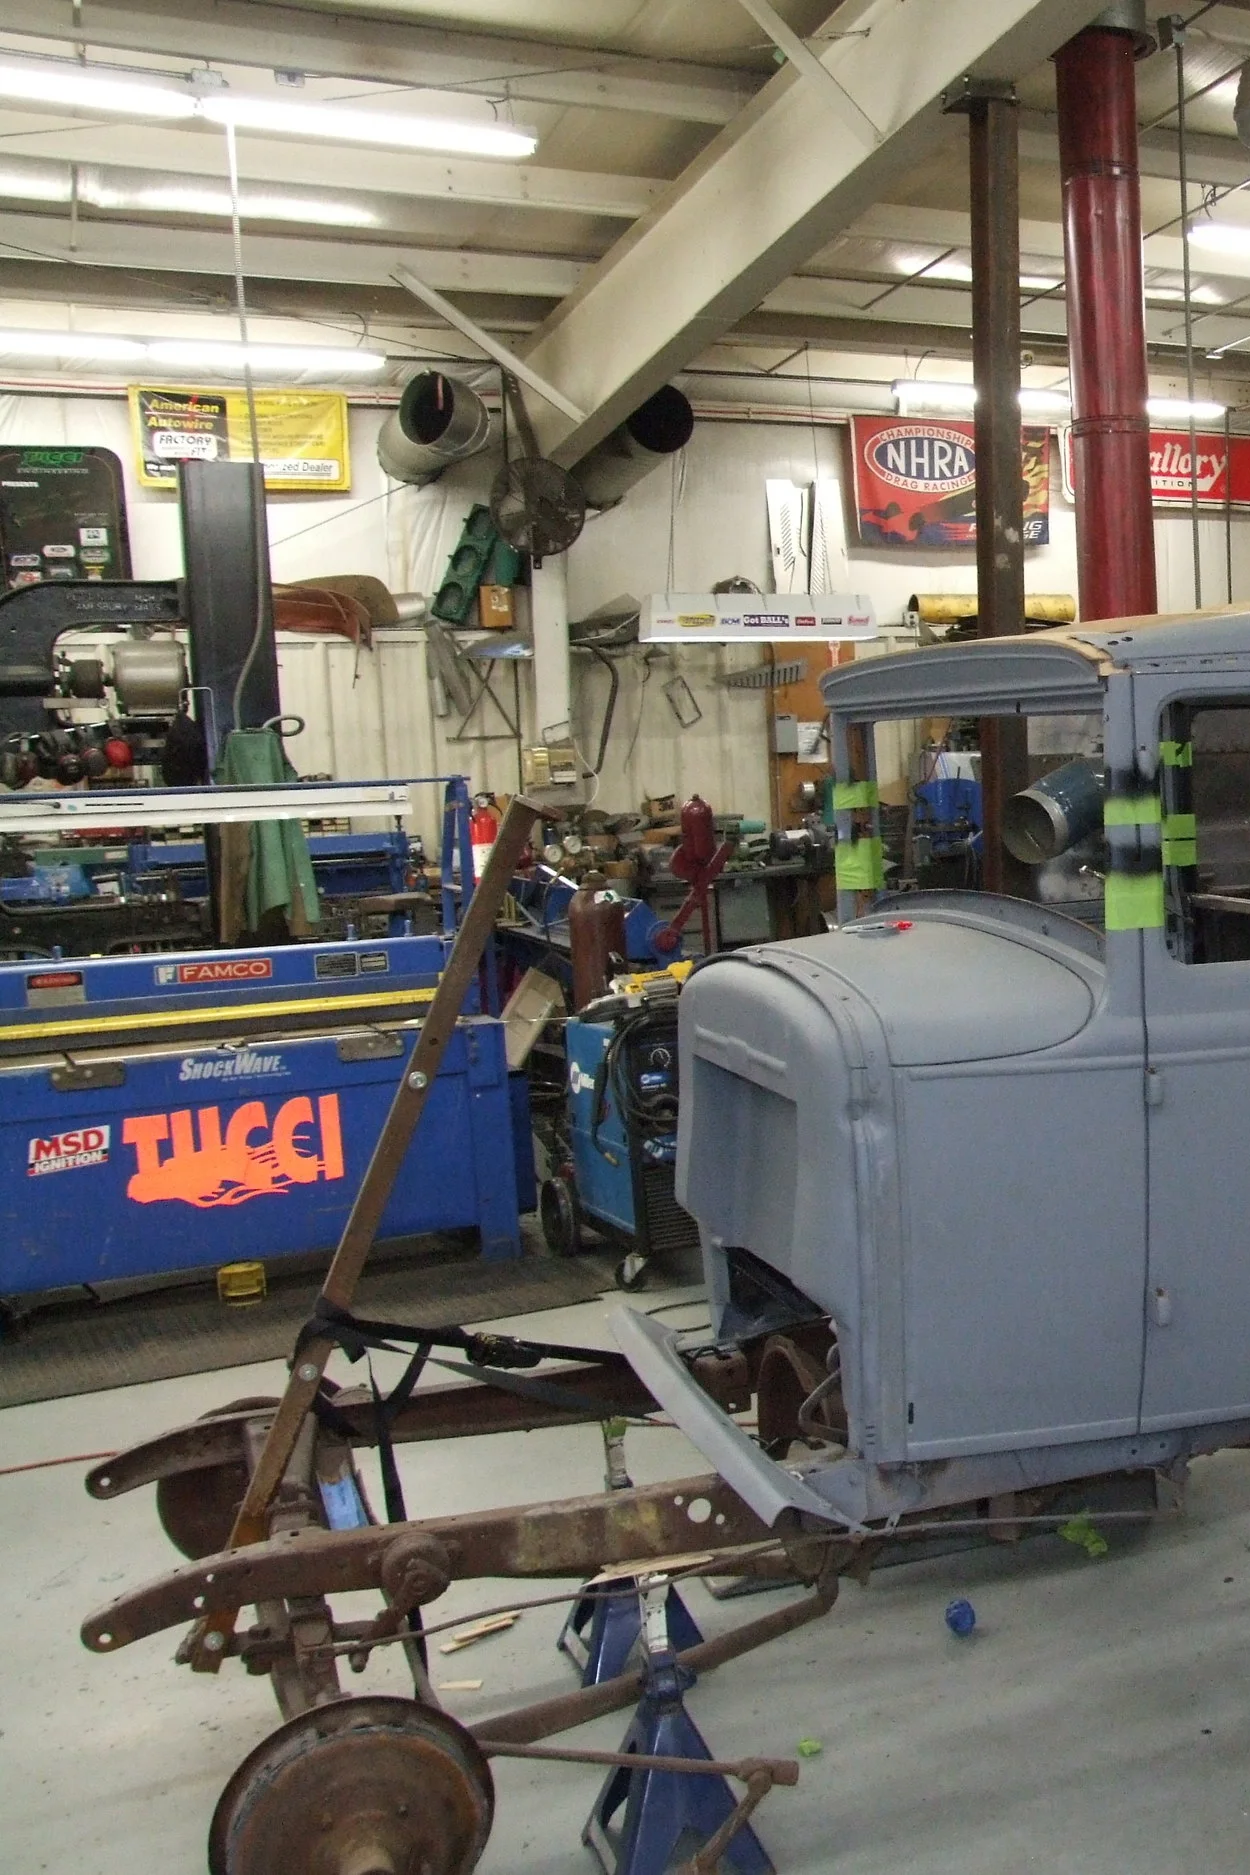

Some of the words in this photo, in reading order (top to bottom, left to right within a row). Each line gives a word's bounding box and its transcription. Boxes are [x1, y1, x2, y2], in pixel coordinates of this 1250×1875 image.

[149, 400, 219, 413] American
[147, 416, 214, 430] Autowire
[158, 434, 212, 446] FACTORY
[301, 461, 333, 473] Dealer
[886, 439, 969, 479] NHRA
[1149, 441, 1227, 476] allory
[884, 471, 919, 490] DRAG
[743, 616, 759, 624] Got
[182, 961, 267, 983] FAMCO
[34, 1128, 105, 1161] MSD
[122, 1093, 345, 1198] TUCCI
[34, 1150, 103, 1174] IGNITION
